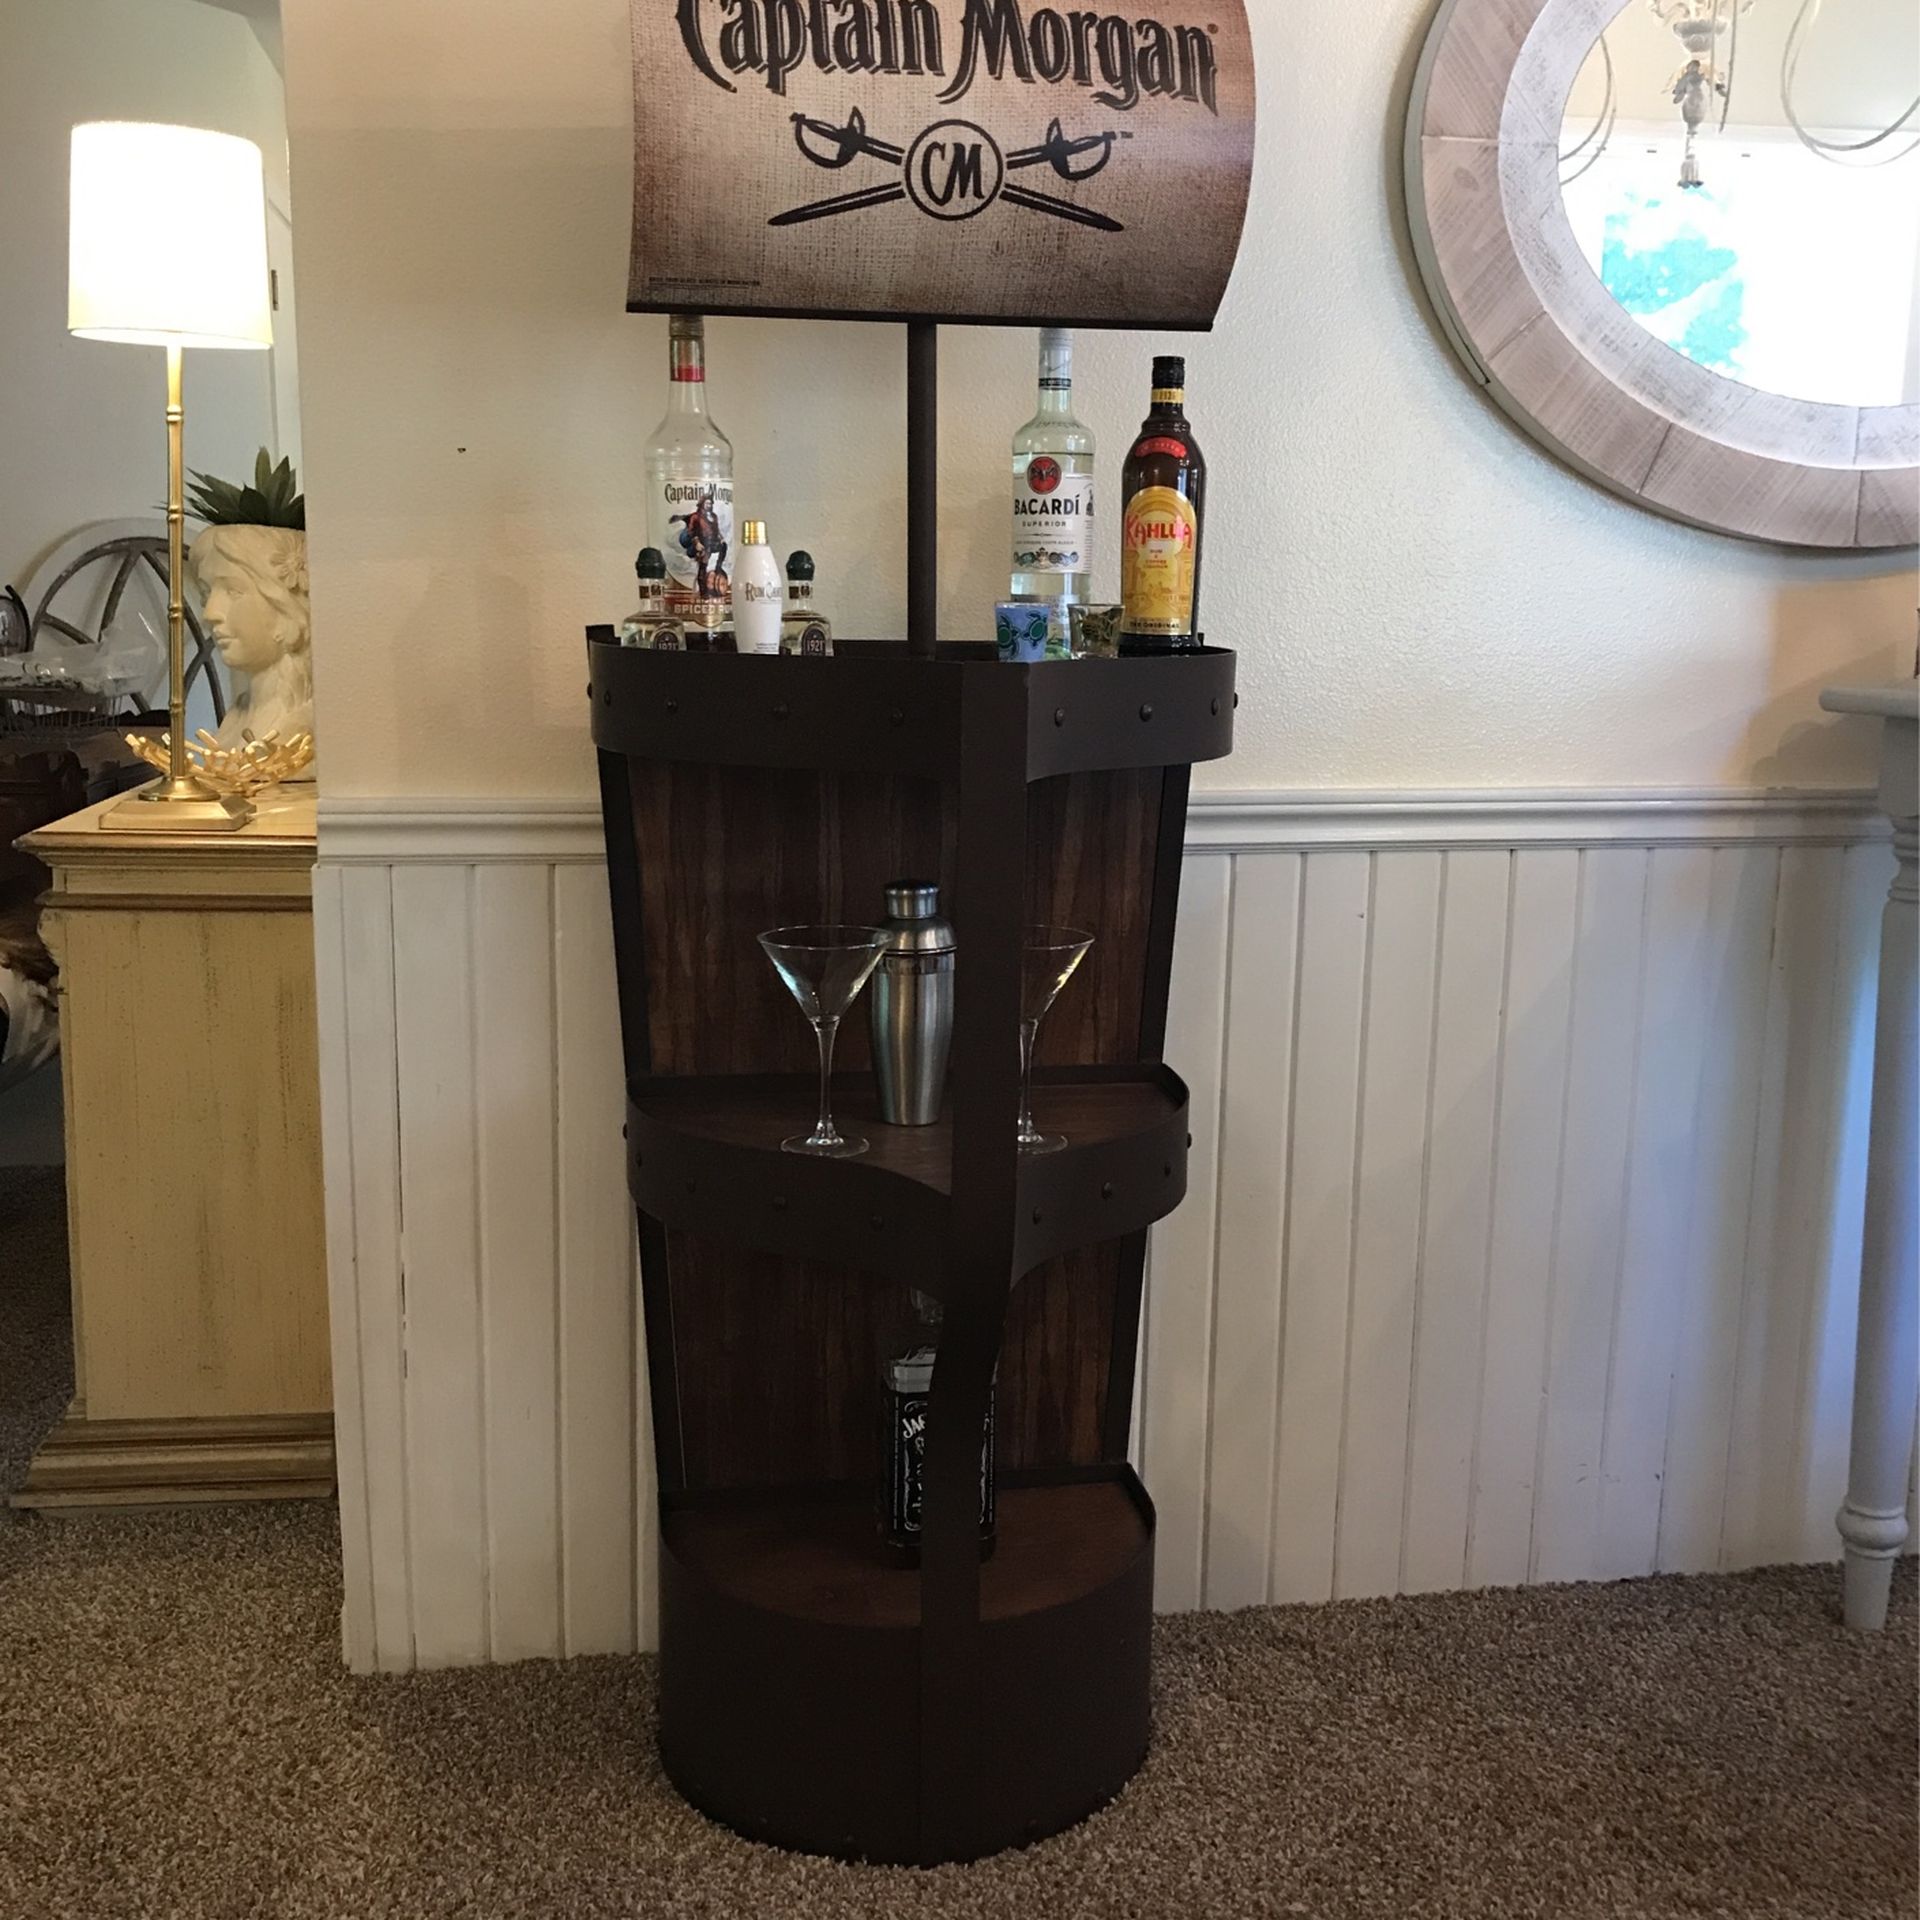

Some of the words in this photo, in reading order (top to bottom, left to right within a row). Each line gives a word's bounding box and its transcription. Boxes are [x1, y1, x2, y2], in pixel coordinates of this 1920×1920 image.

[675, 0, 944, 95] Captain
[934, 0, 1218, 117] Morgan
[920, 141, 986, 207] CM
[664, 482, 705, 505] Captain
[1013, 493, 1081, 516] BACARDÍ
[1021, 520, 1067, 528] SUPERIOR
[673, 603, 716, 615] SPICED
[806, 639, 824, 652] 1921
